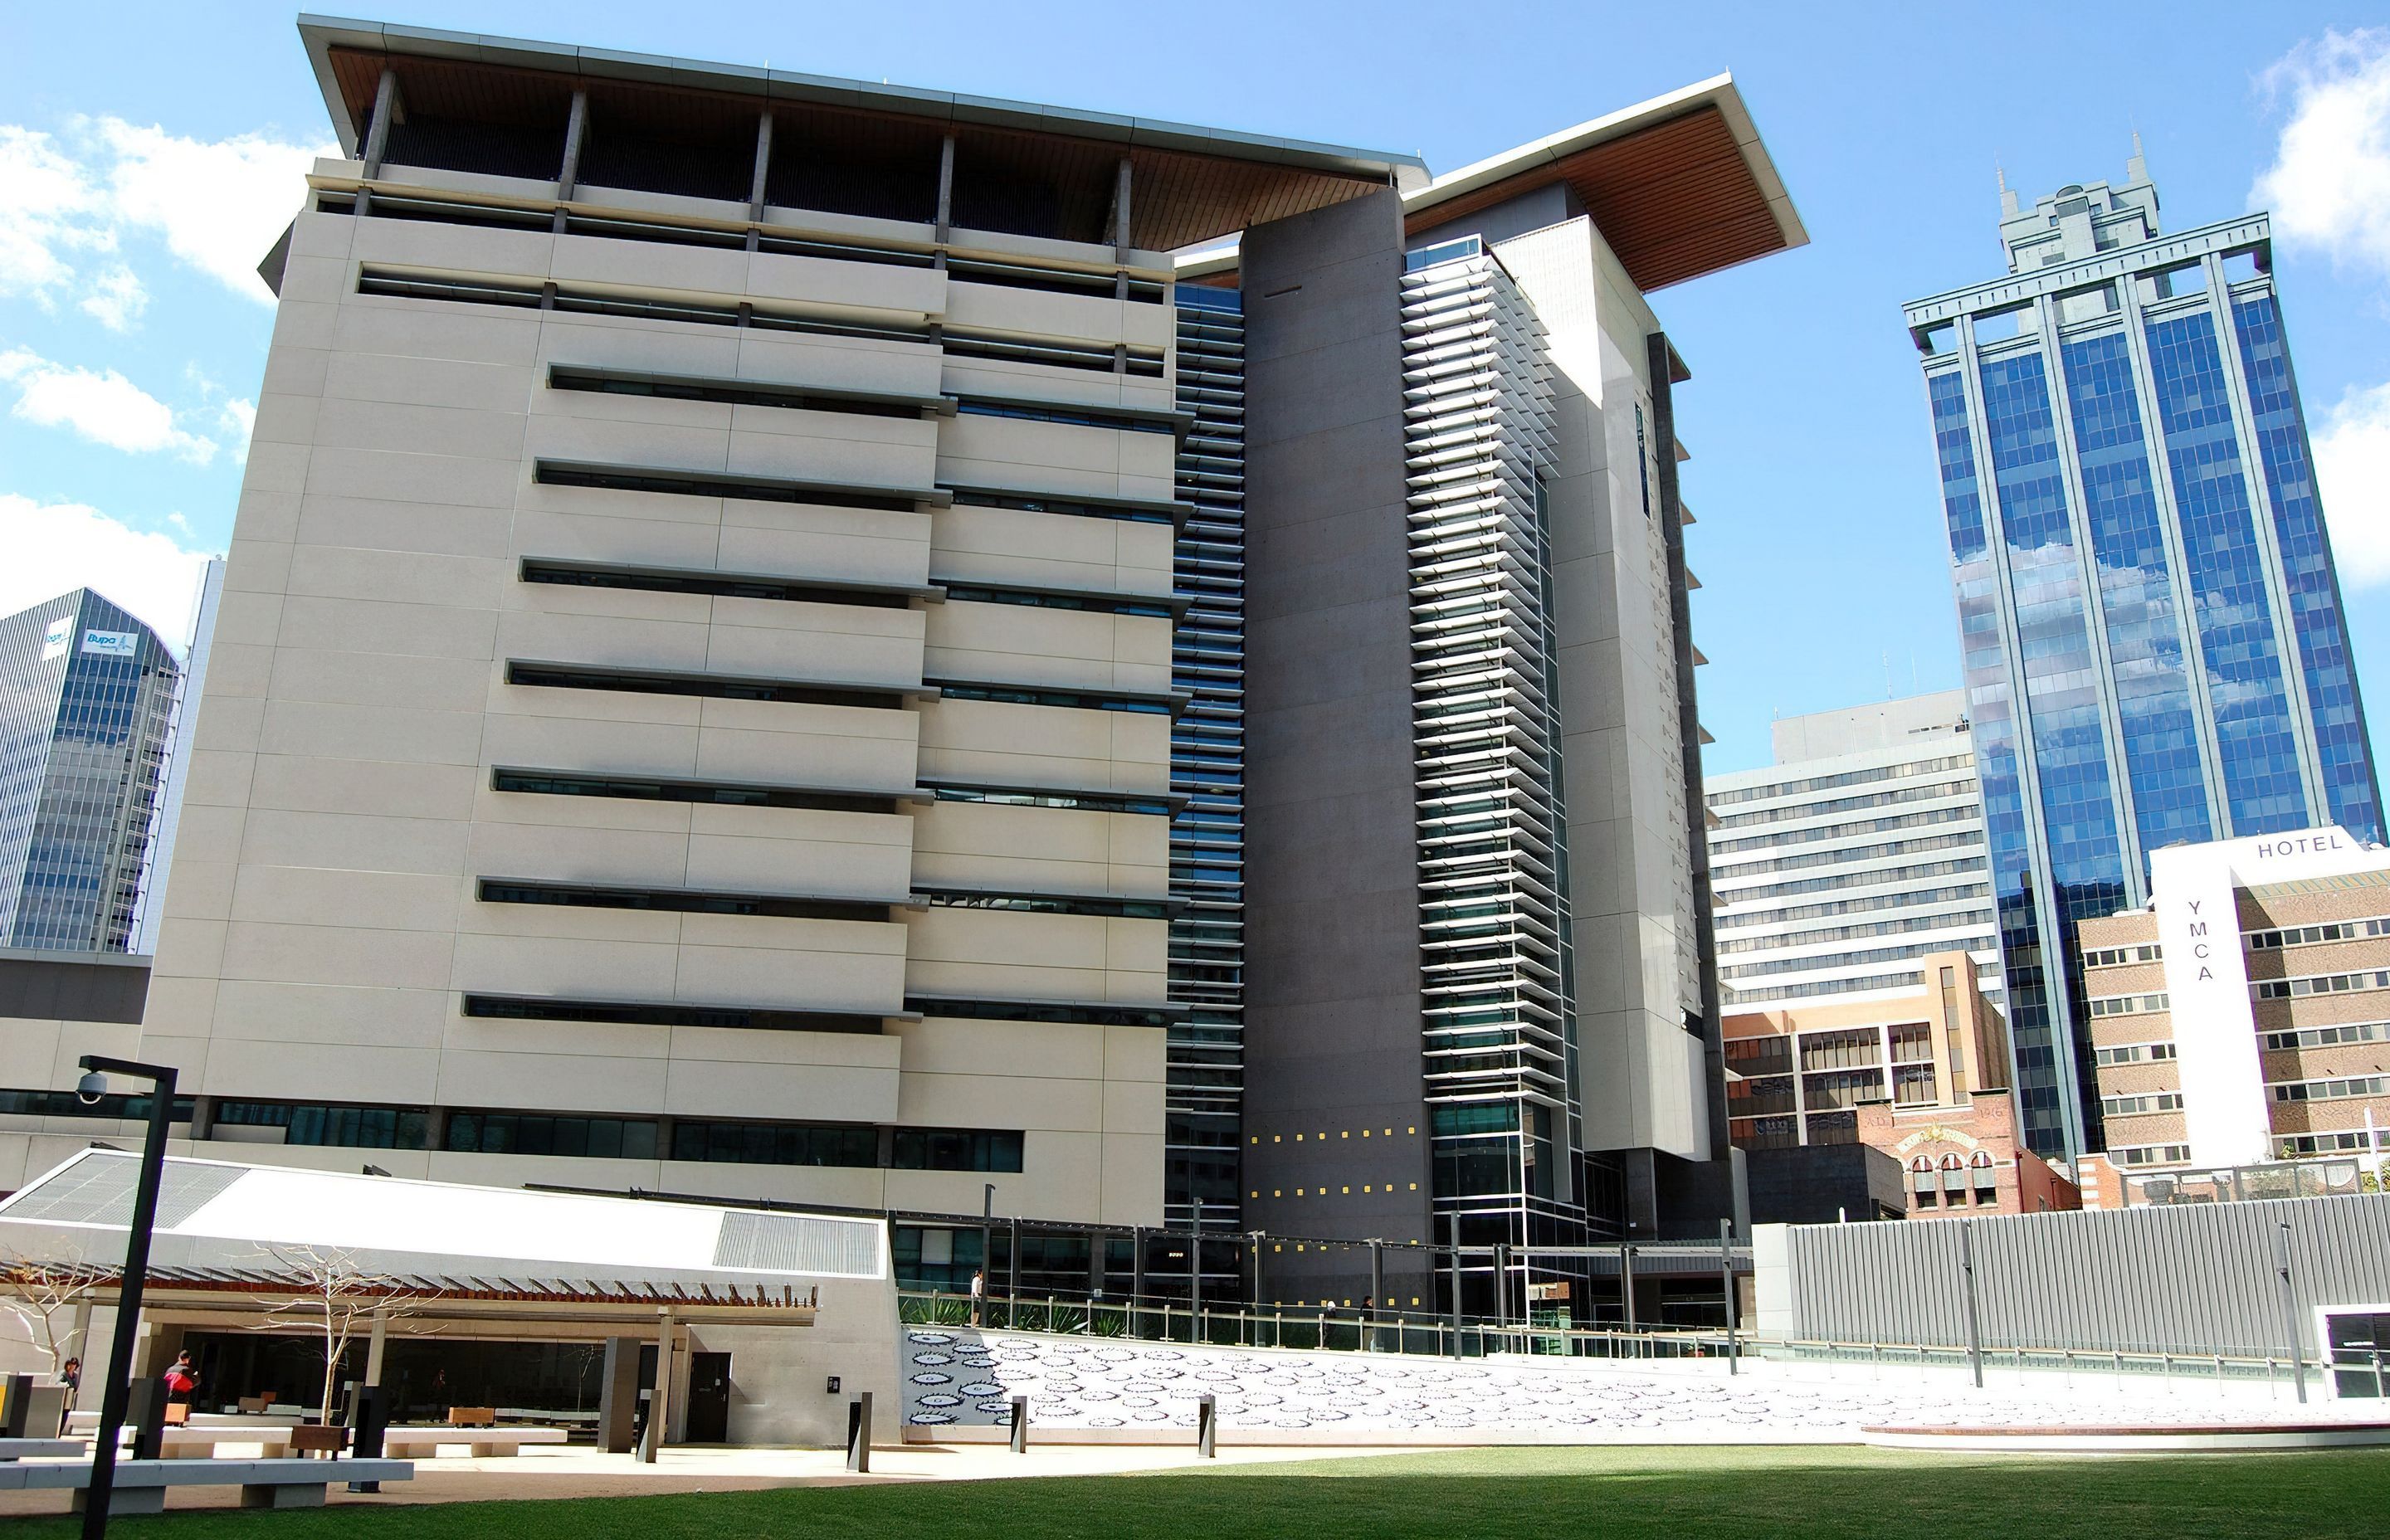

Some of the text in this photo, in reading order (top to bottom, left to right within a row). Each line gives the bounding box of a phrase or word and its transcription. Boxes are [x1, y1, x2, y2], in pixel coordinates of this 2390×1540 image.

[87, 633, 116, 644] Bupa
[2258, 835, 2344, 858] HOTEL
[2188, 900, 2213, 981] YMCA
